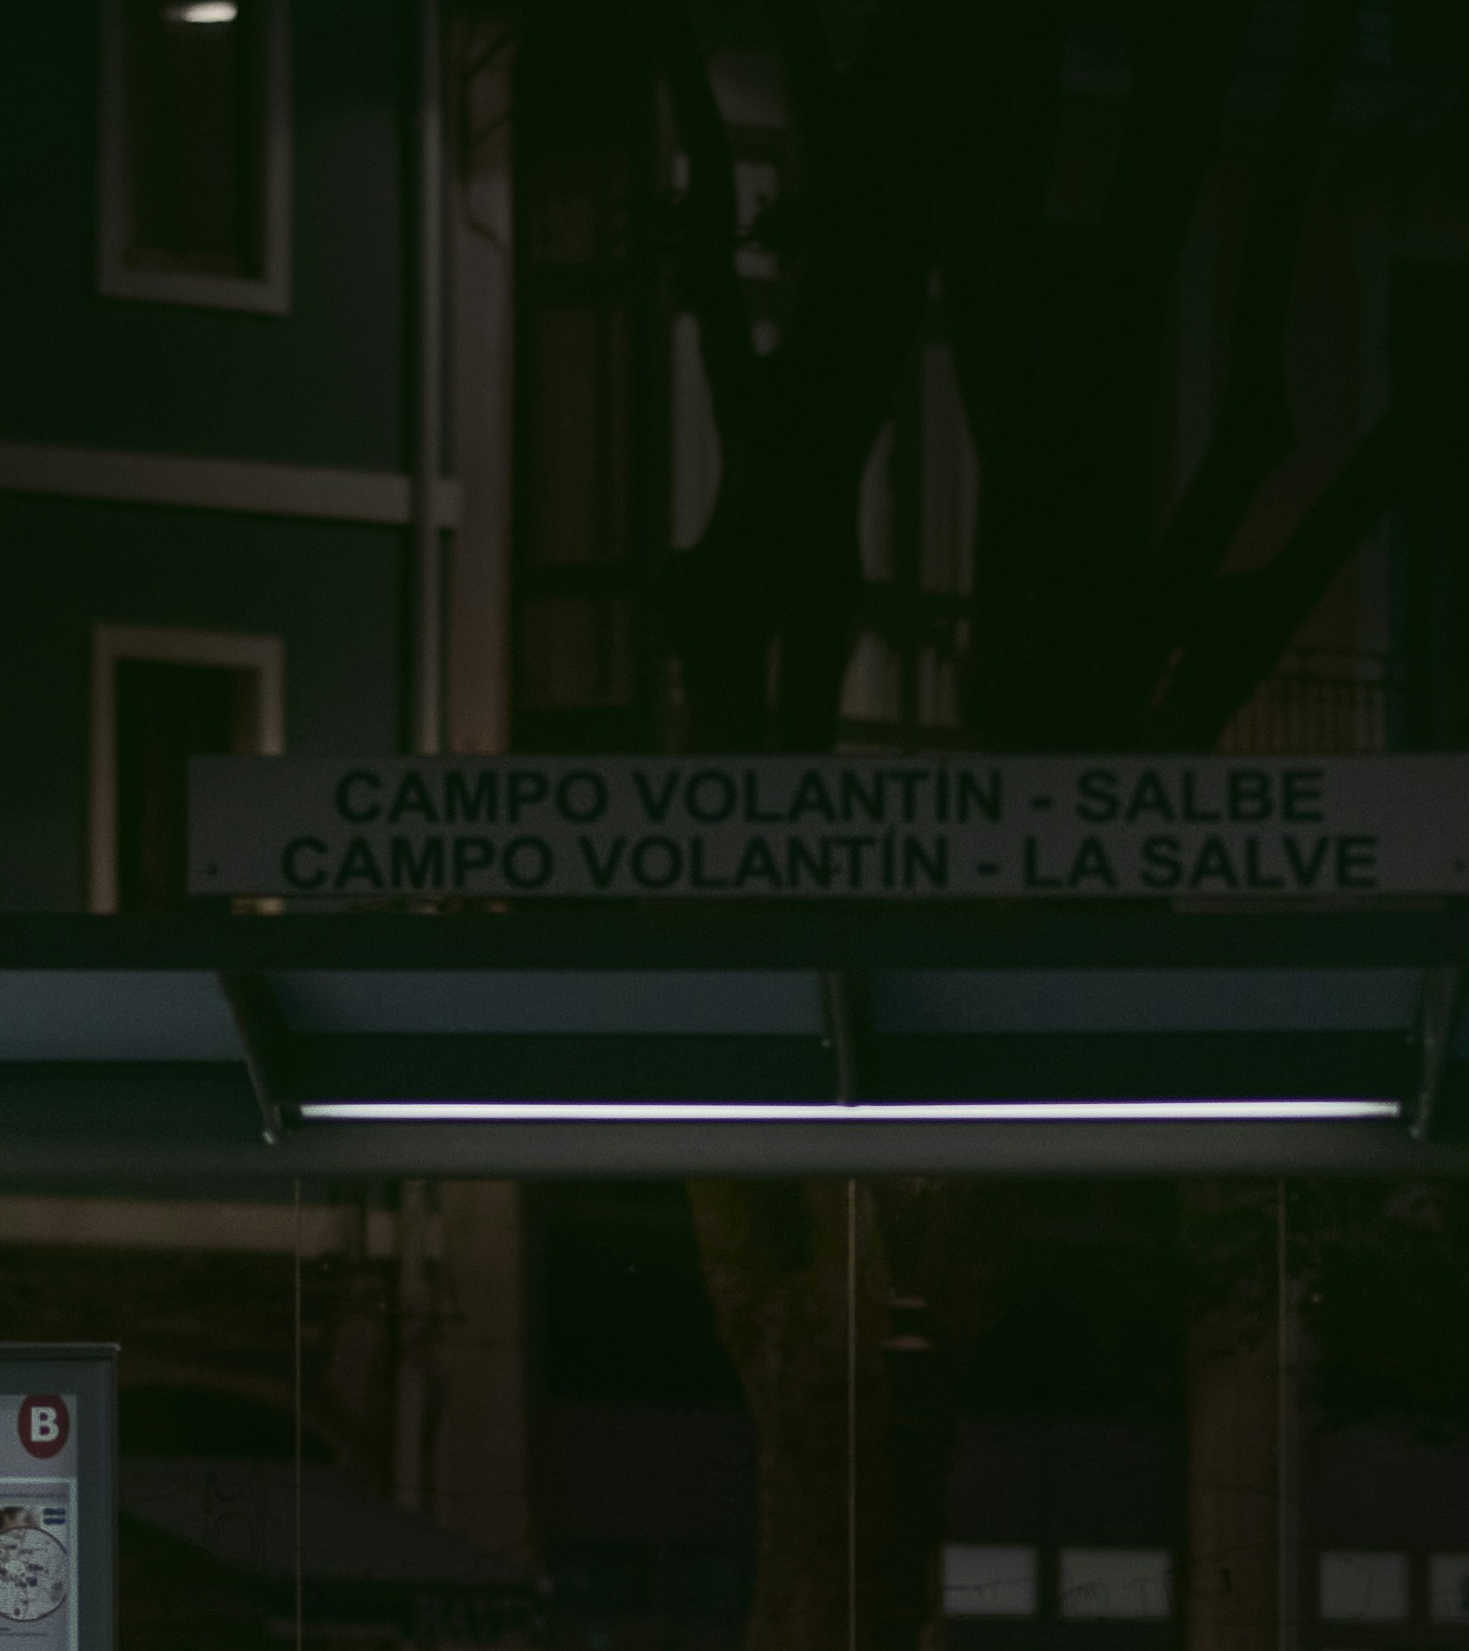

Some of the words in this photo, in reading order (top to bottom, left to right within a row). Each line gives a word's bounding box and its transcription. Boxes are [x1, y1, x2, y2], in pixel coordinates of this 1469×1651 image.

[335, 769, 608, 826] CAMPO
[633, 756, 1002, 825] VOLANTÍN
[1075, 768, 1324, 824] SALBE
[281, 834, 555, 892] CAMPO
[578, 824, 948, 891] VOLANTÍN
[1023, 835, 1118, 890] LA
[1139, 834, 1377, 891] SALVE
[31, 1406, 60, 1442] B
